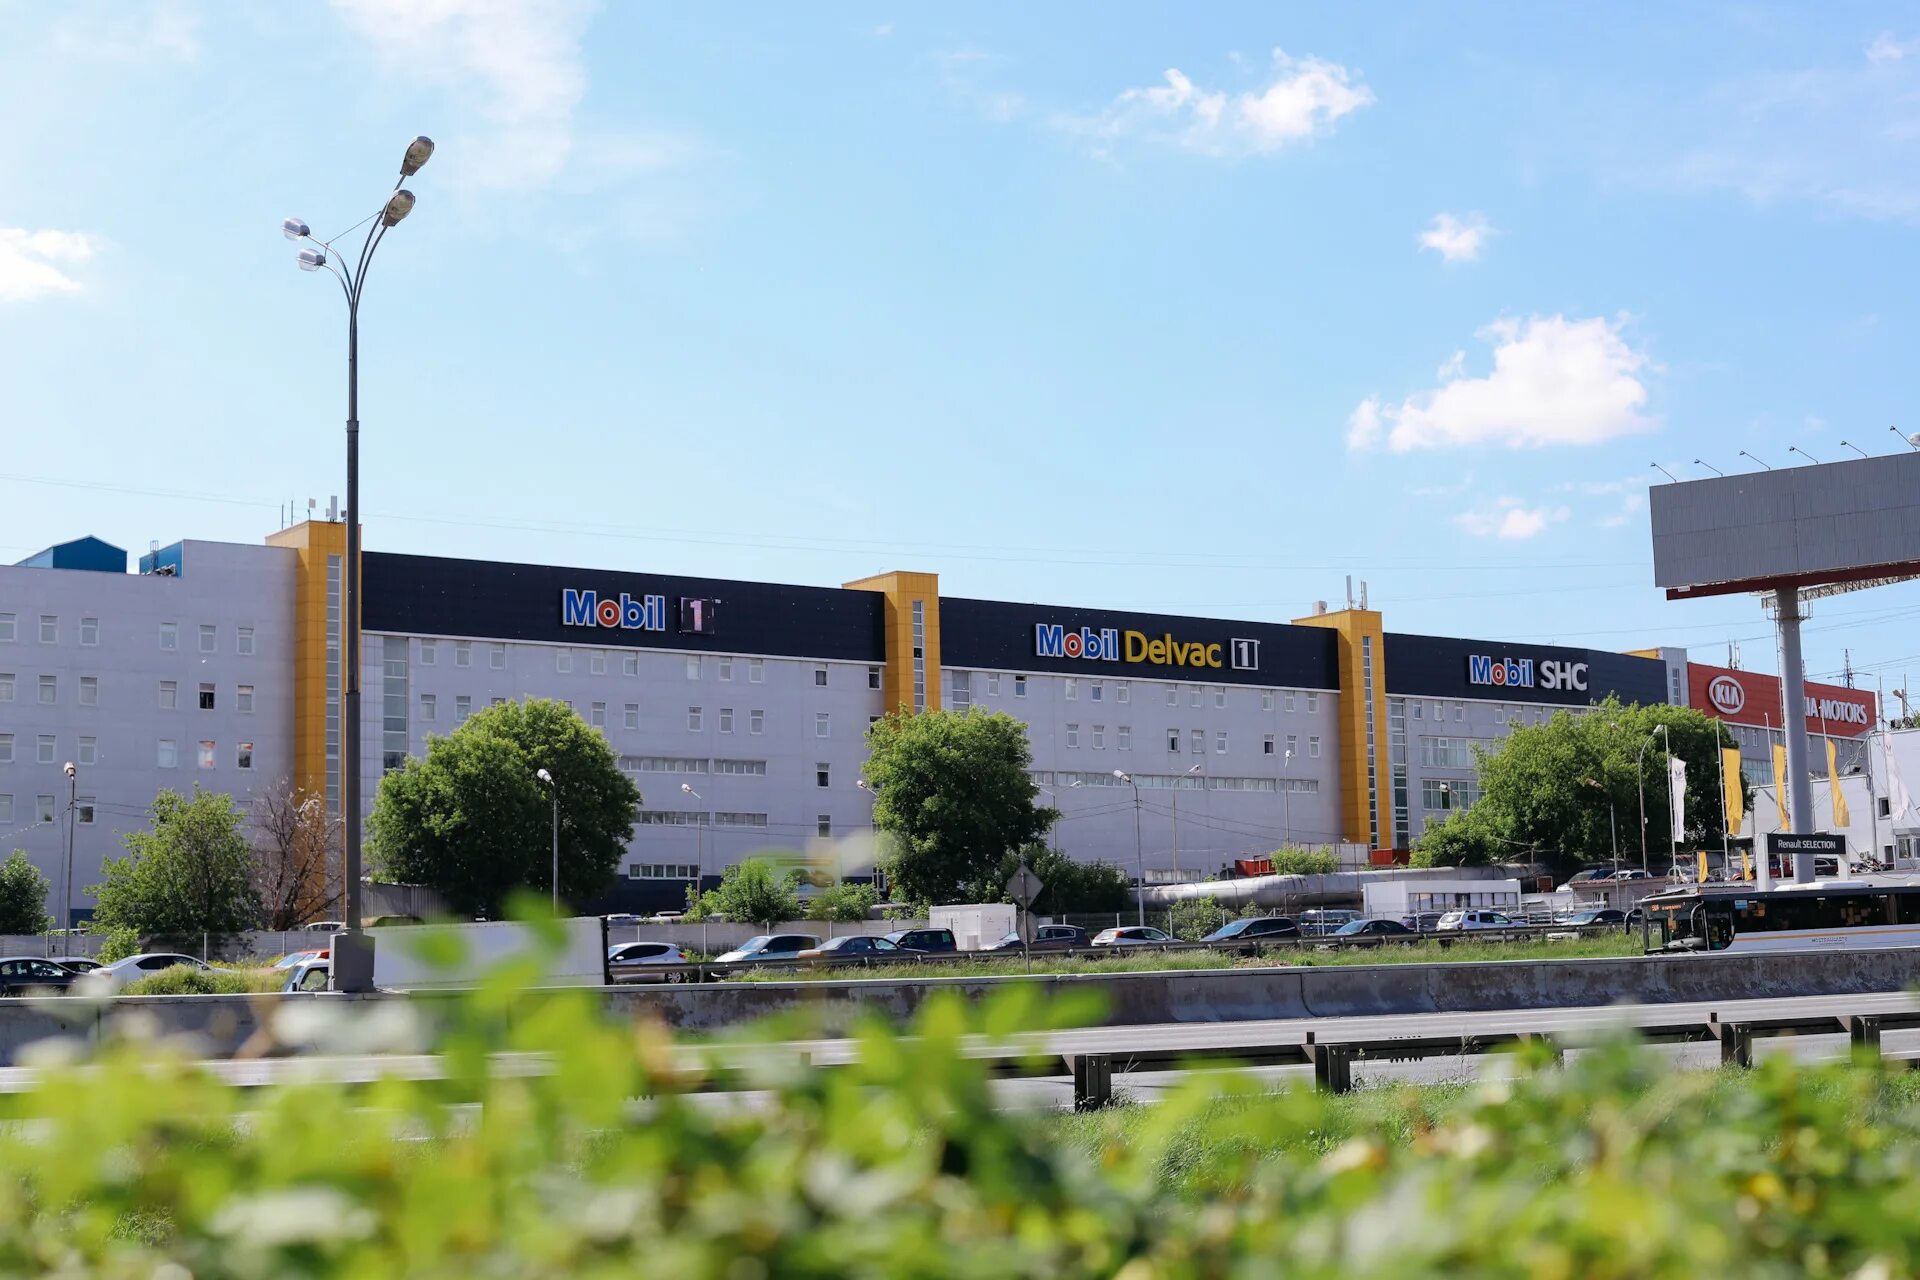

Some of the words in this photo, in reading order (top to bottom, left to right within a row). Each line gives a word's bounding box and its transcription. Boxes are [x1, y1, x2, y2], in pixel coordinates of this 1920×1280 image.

[563, 589, 666, 631] Mobil
[1036, 624, 1119, 661] Mobil
[1124, 630, 1223, 668] Delvac
[1469, 655, 1534, 688] Mobil
[1540, 660, 1588, 691] SHC
[1715, 684, 1740, 706] KIA
[1804, 697, 1819, 718] IA
[1820, 699, 1868, 725] MOTORS
[1778, 839, 1801, 849] Renault
[1802, 840, 1836, 849] SELECTION
